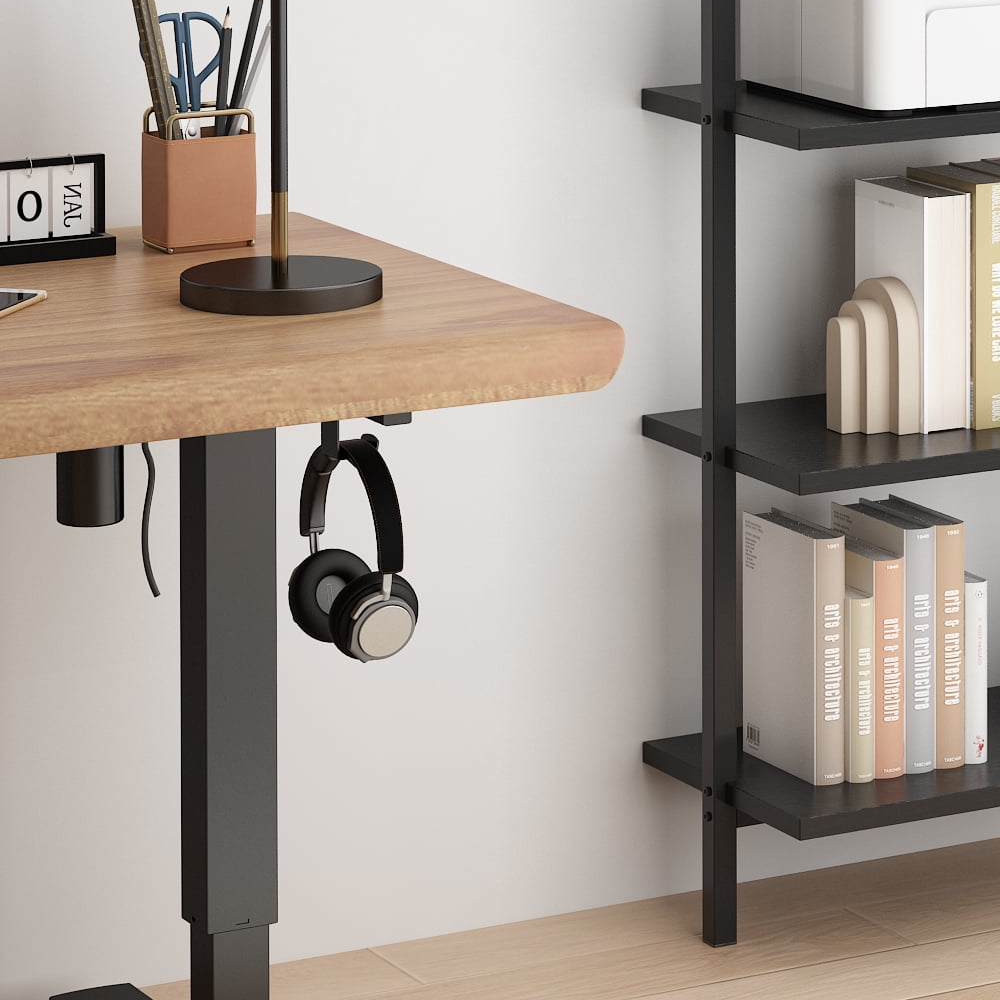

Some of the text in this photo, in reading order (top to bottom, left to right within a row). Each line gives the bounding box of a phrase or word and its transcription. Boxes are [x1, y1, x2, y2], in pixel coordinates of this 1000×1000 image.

[858, 648, 870, 666] arts
[884, 618, 900, 639] arts
[914, 594, 932, 710] arts & architecture
[944, 589, 962, 706] arts & architecture
[824, 604, 841, 721] arts & architecture
[884, 657, 901, 722] architecture
[858, 681, 871, 736] architecture
